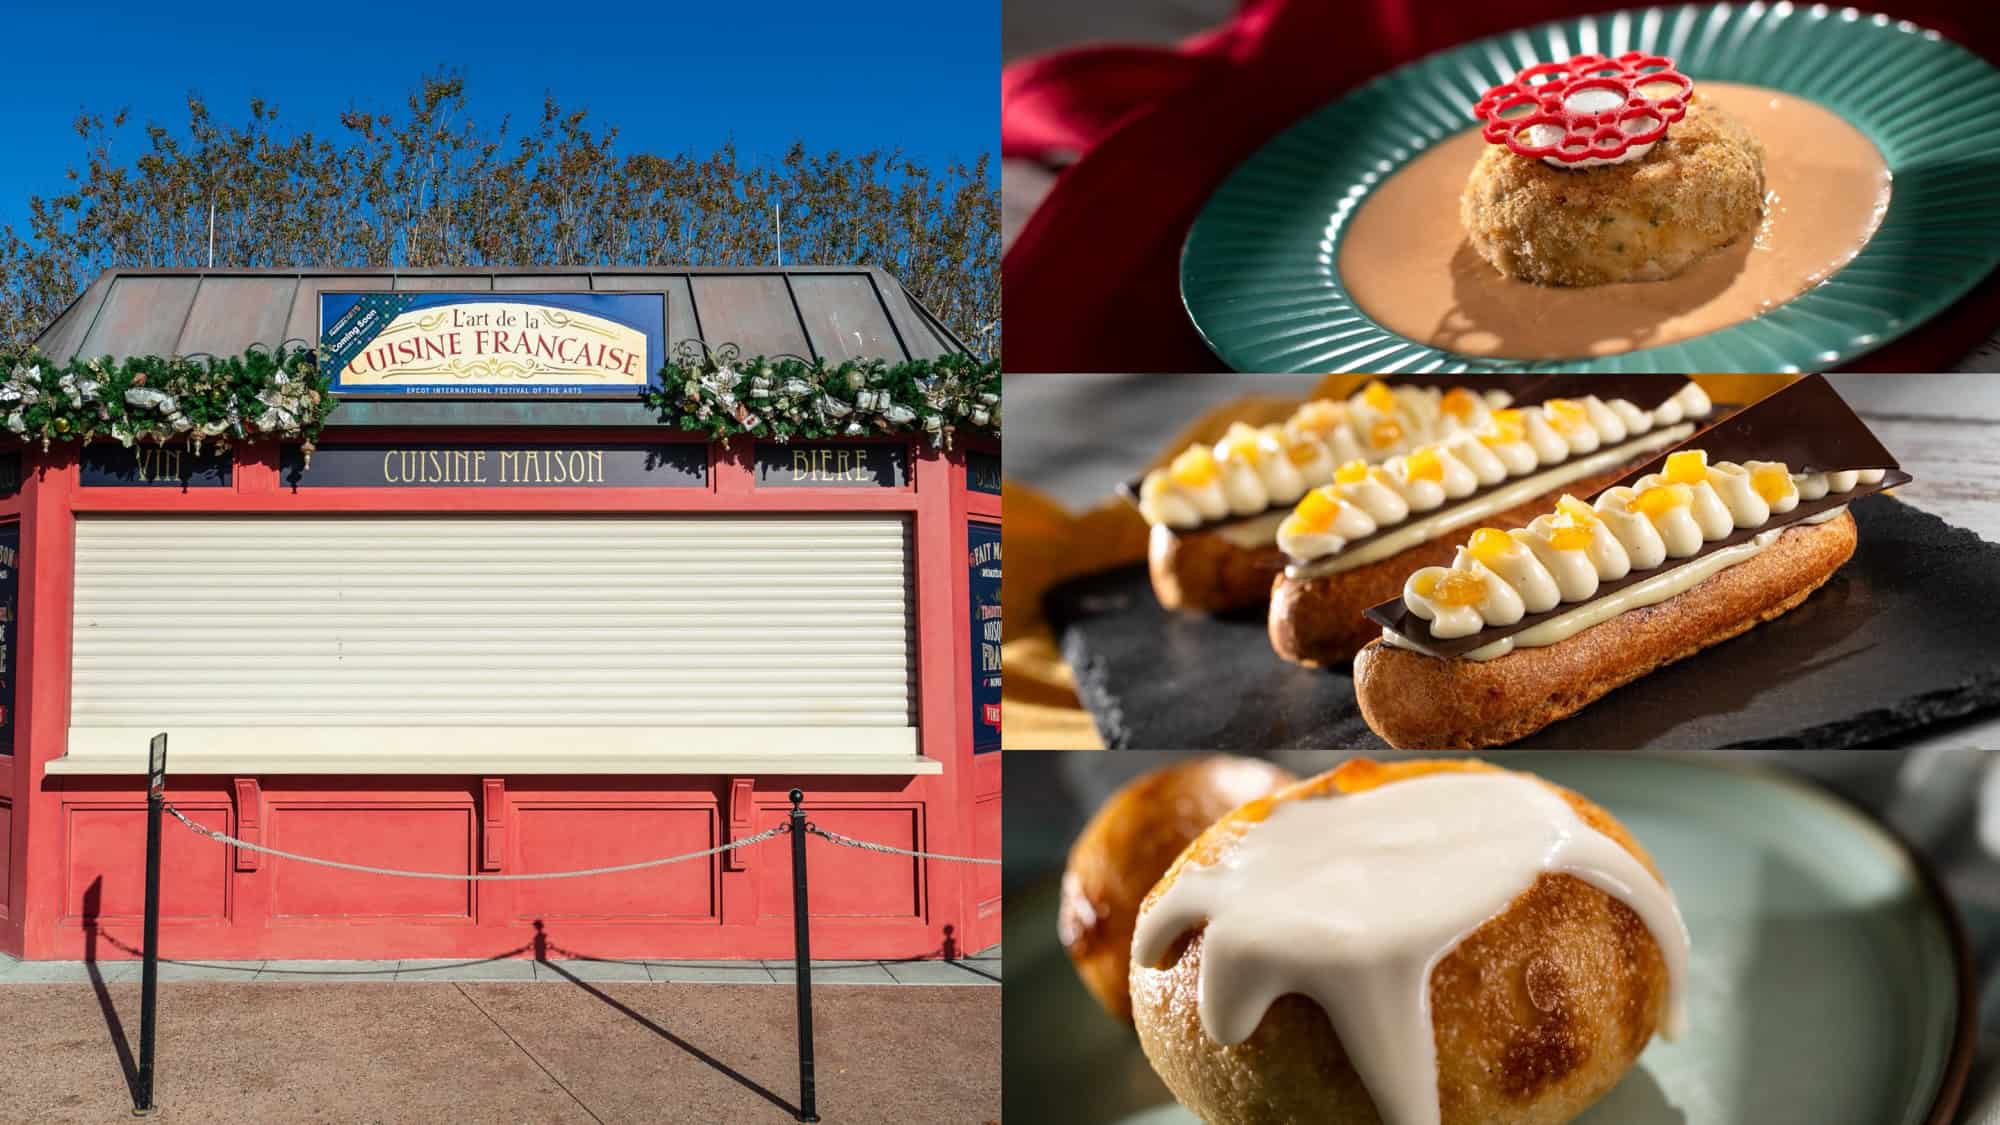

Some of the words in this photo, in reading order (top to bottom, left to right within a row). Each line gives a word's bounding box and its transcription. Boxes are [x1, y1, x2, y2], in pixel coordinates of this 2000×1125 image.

[332, 325, 361, 353] Coming
[356, 309, 377, 328] Soon
[453, 308, 489, 328] L'art
[496, 310, 516, 327] de
[525, 311, 539, 329] la
[475, 330, 640, 377] FRANÇAISE
[432, 386, 492, 394] INTERNATIONAL
[495, 386, 529, 394] FESTIVAL
[532, 386, 542, 394] OF
[545, 386, 560, 394] THE
[563, 386, 583, 394] ARTS
[136, 448, 182, 482] VIN
[383, 449, 488, 483] CUISINE
[499, 449, 605, 483] MAISON
[973, 542, 992, 567] FAIT
